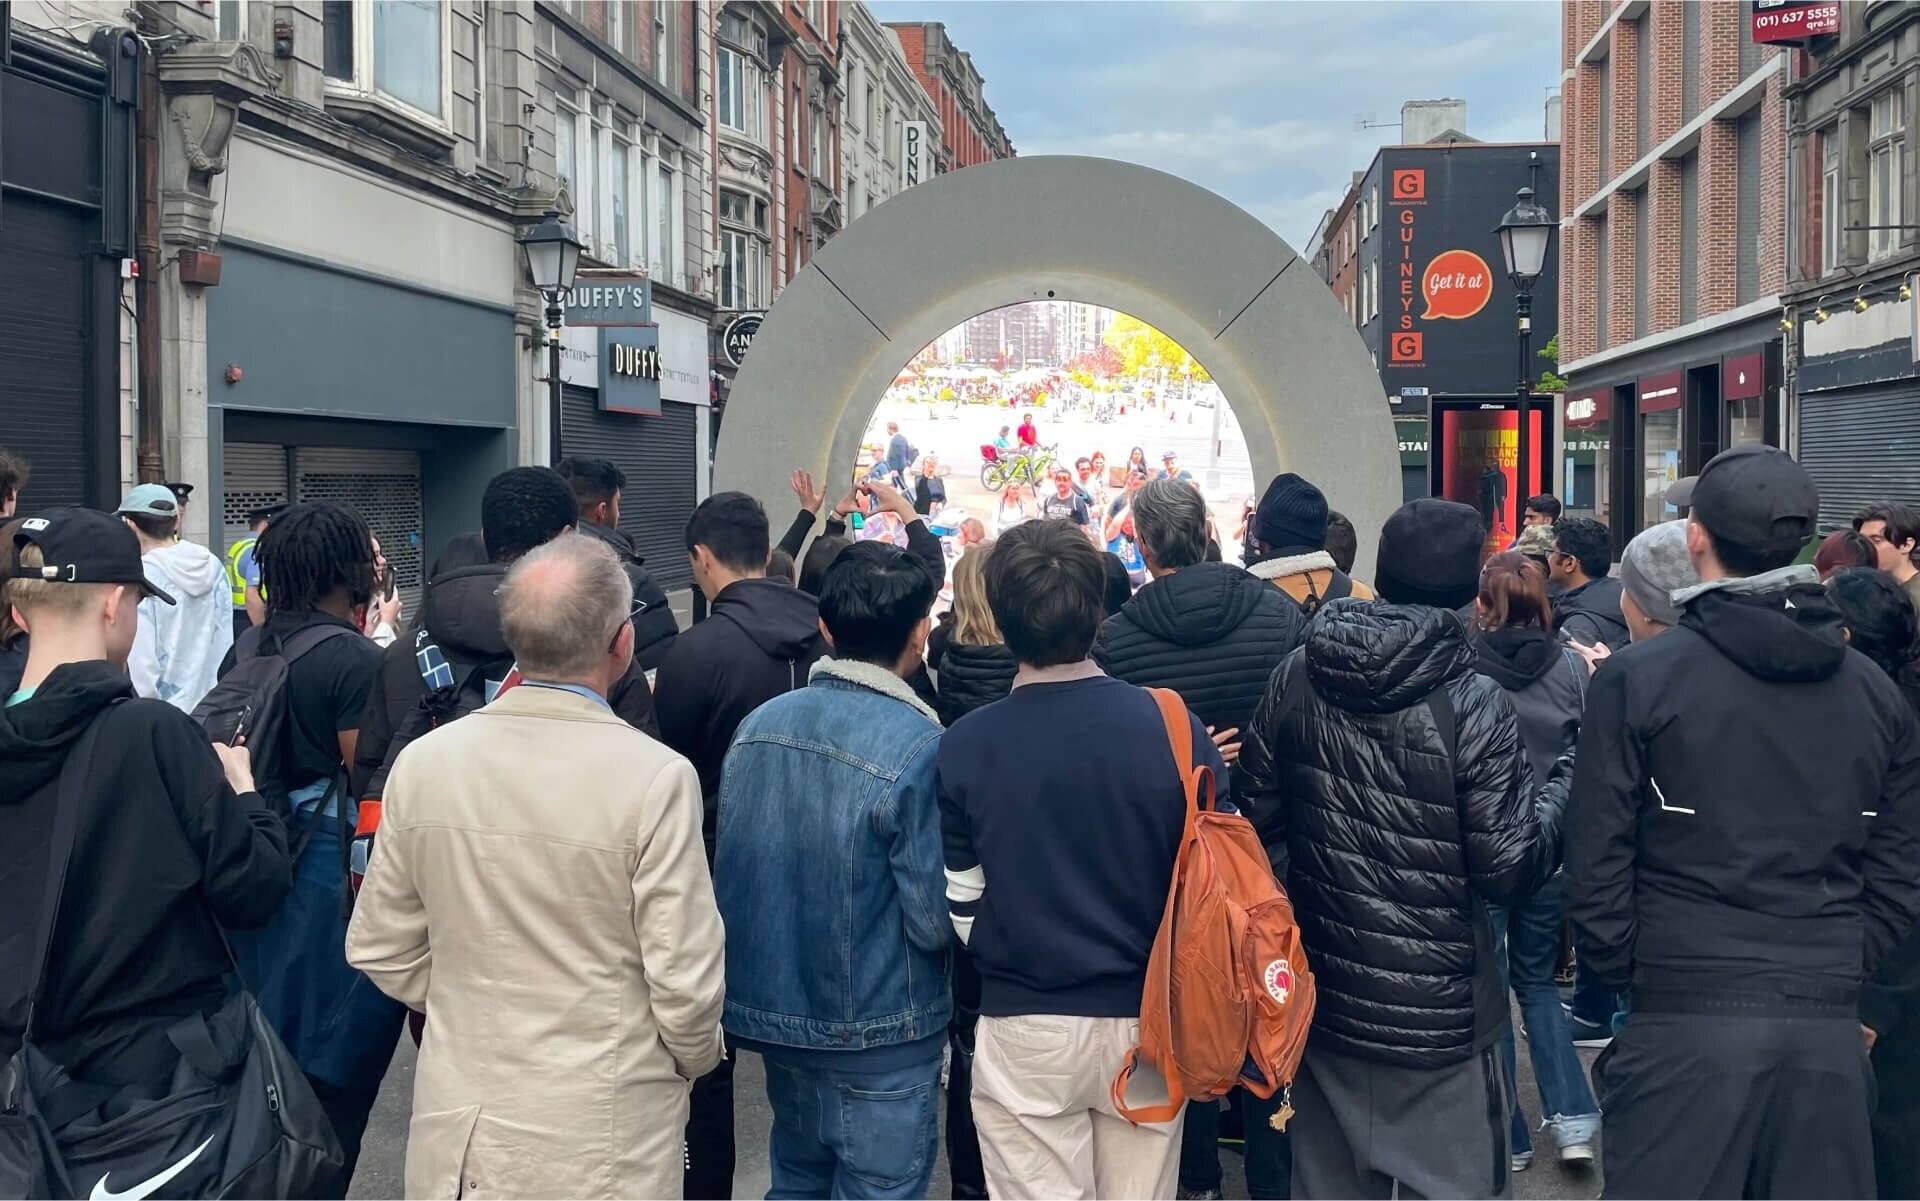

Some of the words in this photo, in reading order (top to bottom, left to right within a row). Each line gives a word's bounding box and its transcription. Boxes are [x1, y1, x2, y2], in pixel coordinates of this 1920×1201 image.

[1756, 15, 1779, 29] (01)
[1782, 11, 1804, 24] 637
[1807, 6, 1837, 20] 5555
[1806, 18, 1836, 30] qre.ie
[1398, 174, 1418, 195] G
[1400, 209, 1414, 329] GUINEYS
[1430, 272, 1452, 296] Get
[1455, 272, 1466, 289] it
[1468, 272, 1483, 289] at
[567, 284, 643, 308] DUFFY'S
[730, 333, 756, 347] AN
[1397, 336, 1417, 357] G
[615, 343, 664, 381] DUFFY'S
[1499, 458, 1517, 468] TOU
